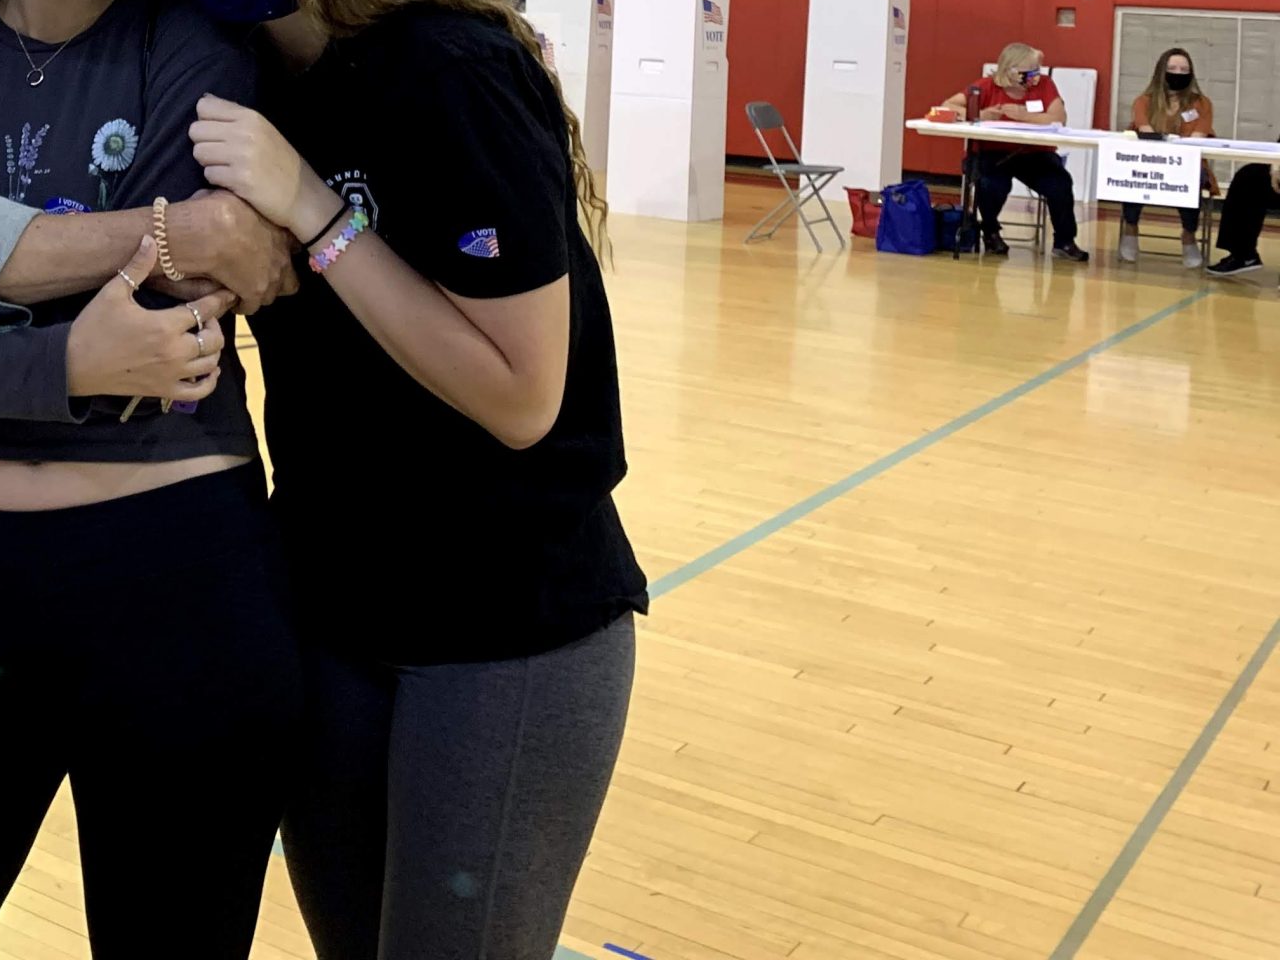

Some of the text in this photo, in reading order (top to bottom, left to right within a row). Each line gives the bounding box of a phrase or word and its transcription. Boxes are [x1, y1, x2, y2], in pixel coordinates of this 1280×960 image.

[1116, 152, 1182, 166] Upper Dublin 5-3
[1131, 169, 1164, 181] New Life
[1107, 177, 1189, 193] Presbyterian Church
[62, 198, 85, 211] VOTED
